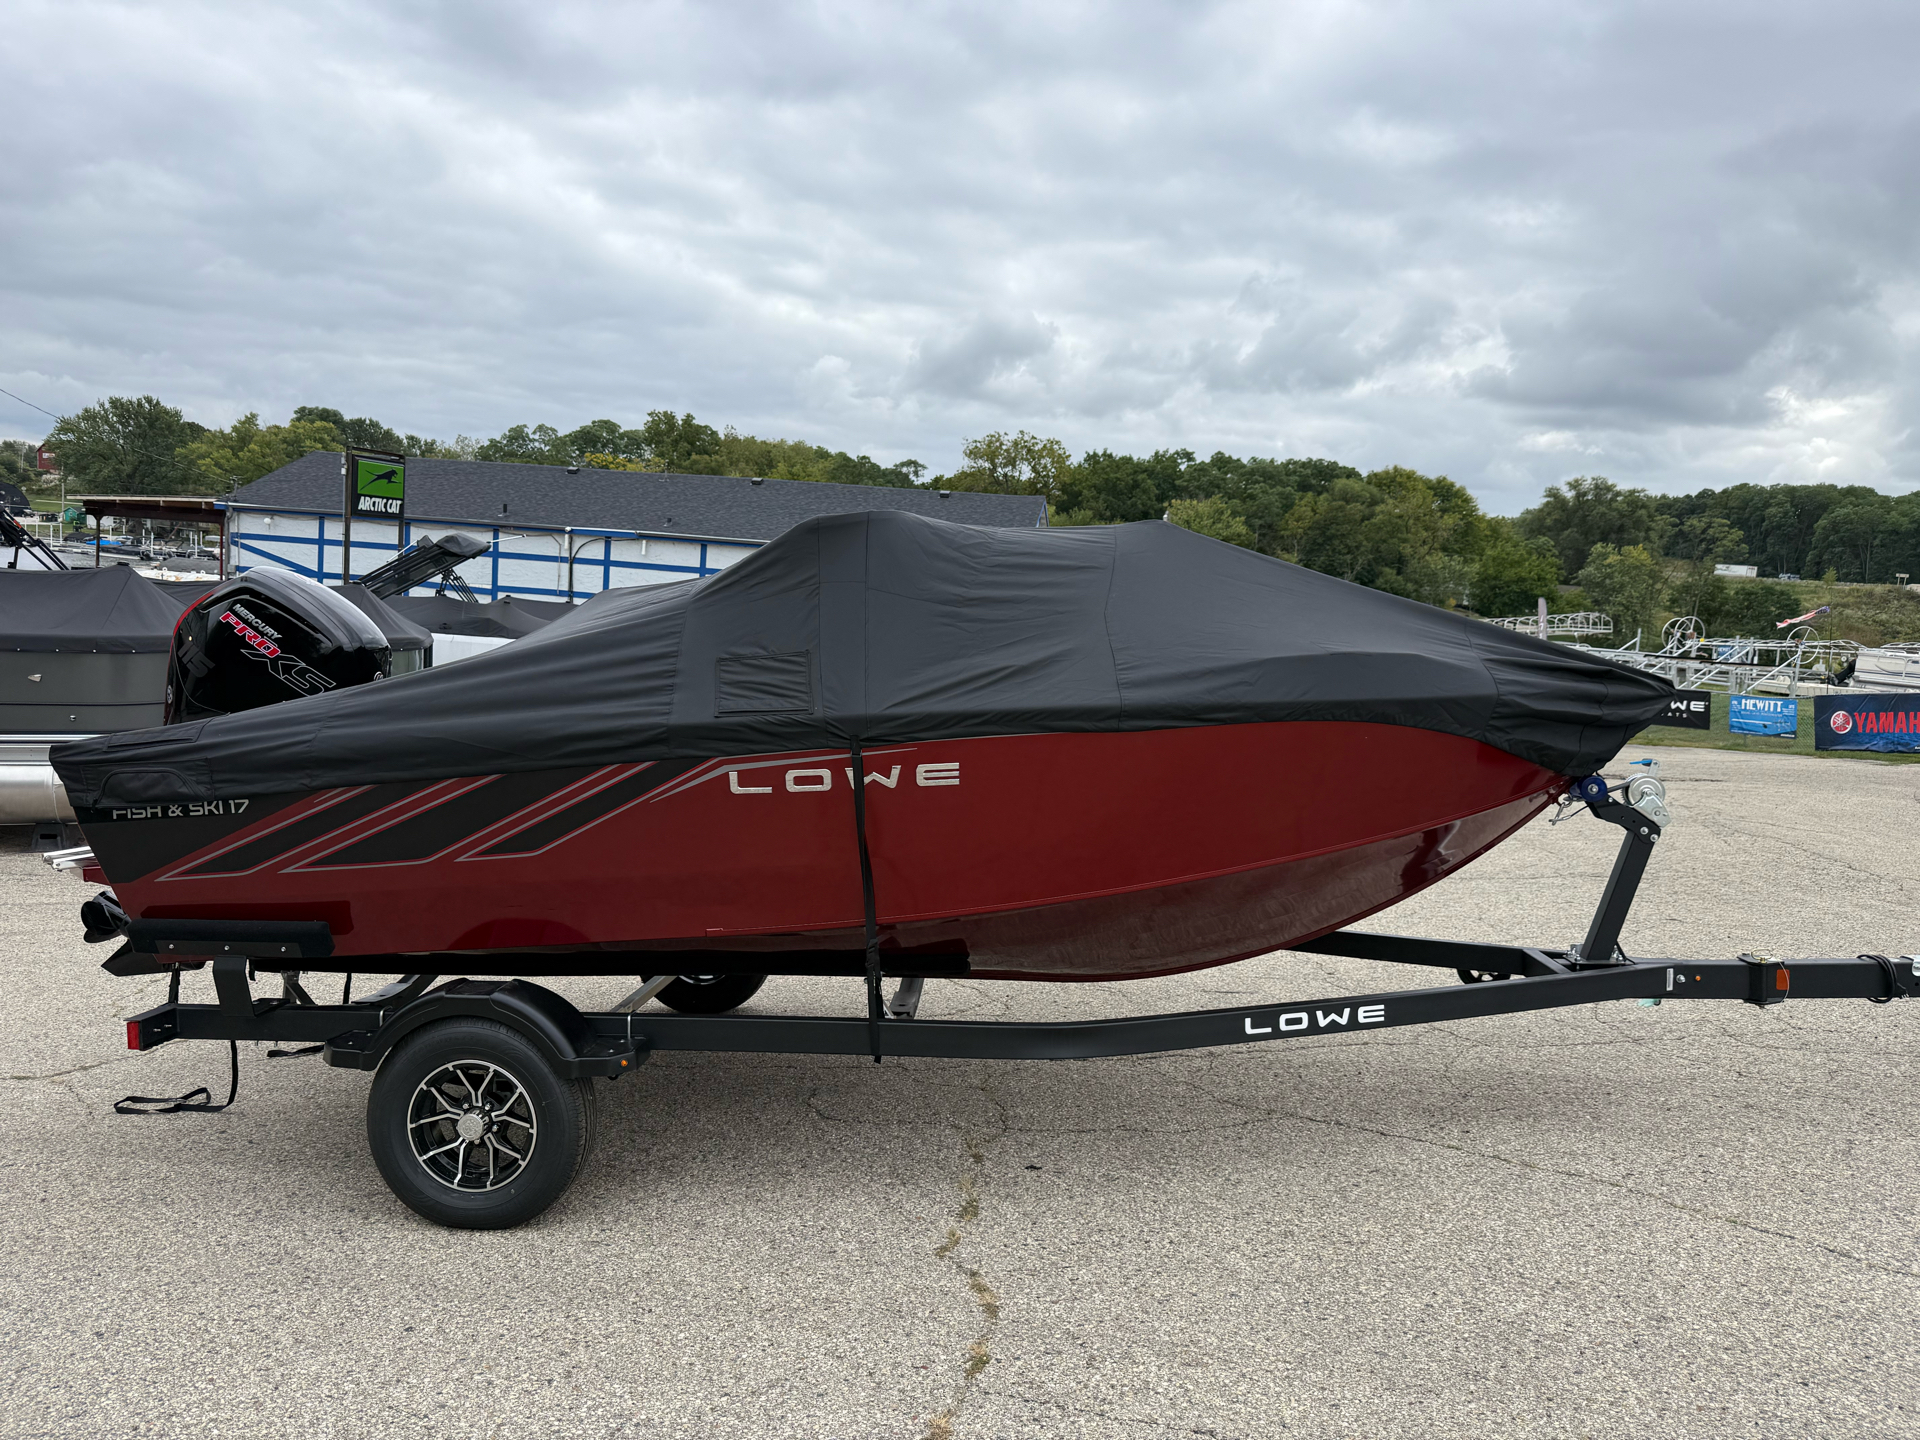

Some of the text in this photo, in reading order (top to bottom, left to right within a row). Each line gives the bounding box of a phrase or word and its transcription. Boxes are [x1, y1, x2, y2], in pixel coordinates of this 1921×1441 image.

[358, 496, 403, 514] ARCTIC CAT
[232, 604, 282, 640] MERCURY
[219, 611, 336, 697] PRO XS
[1741, 698, 1783, 712] HEWITT
[1854, 711, 1920, 733] YAMAH
[729, 763, 960, 794] LOWE
[112, 799, 249, 820] FISH & SKI 17
[1245, 1004, 1385, 1035] LOWE
